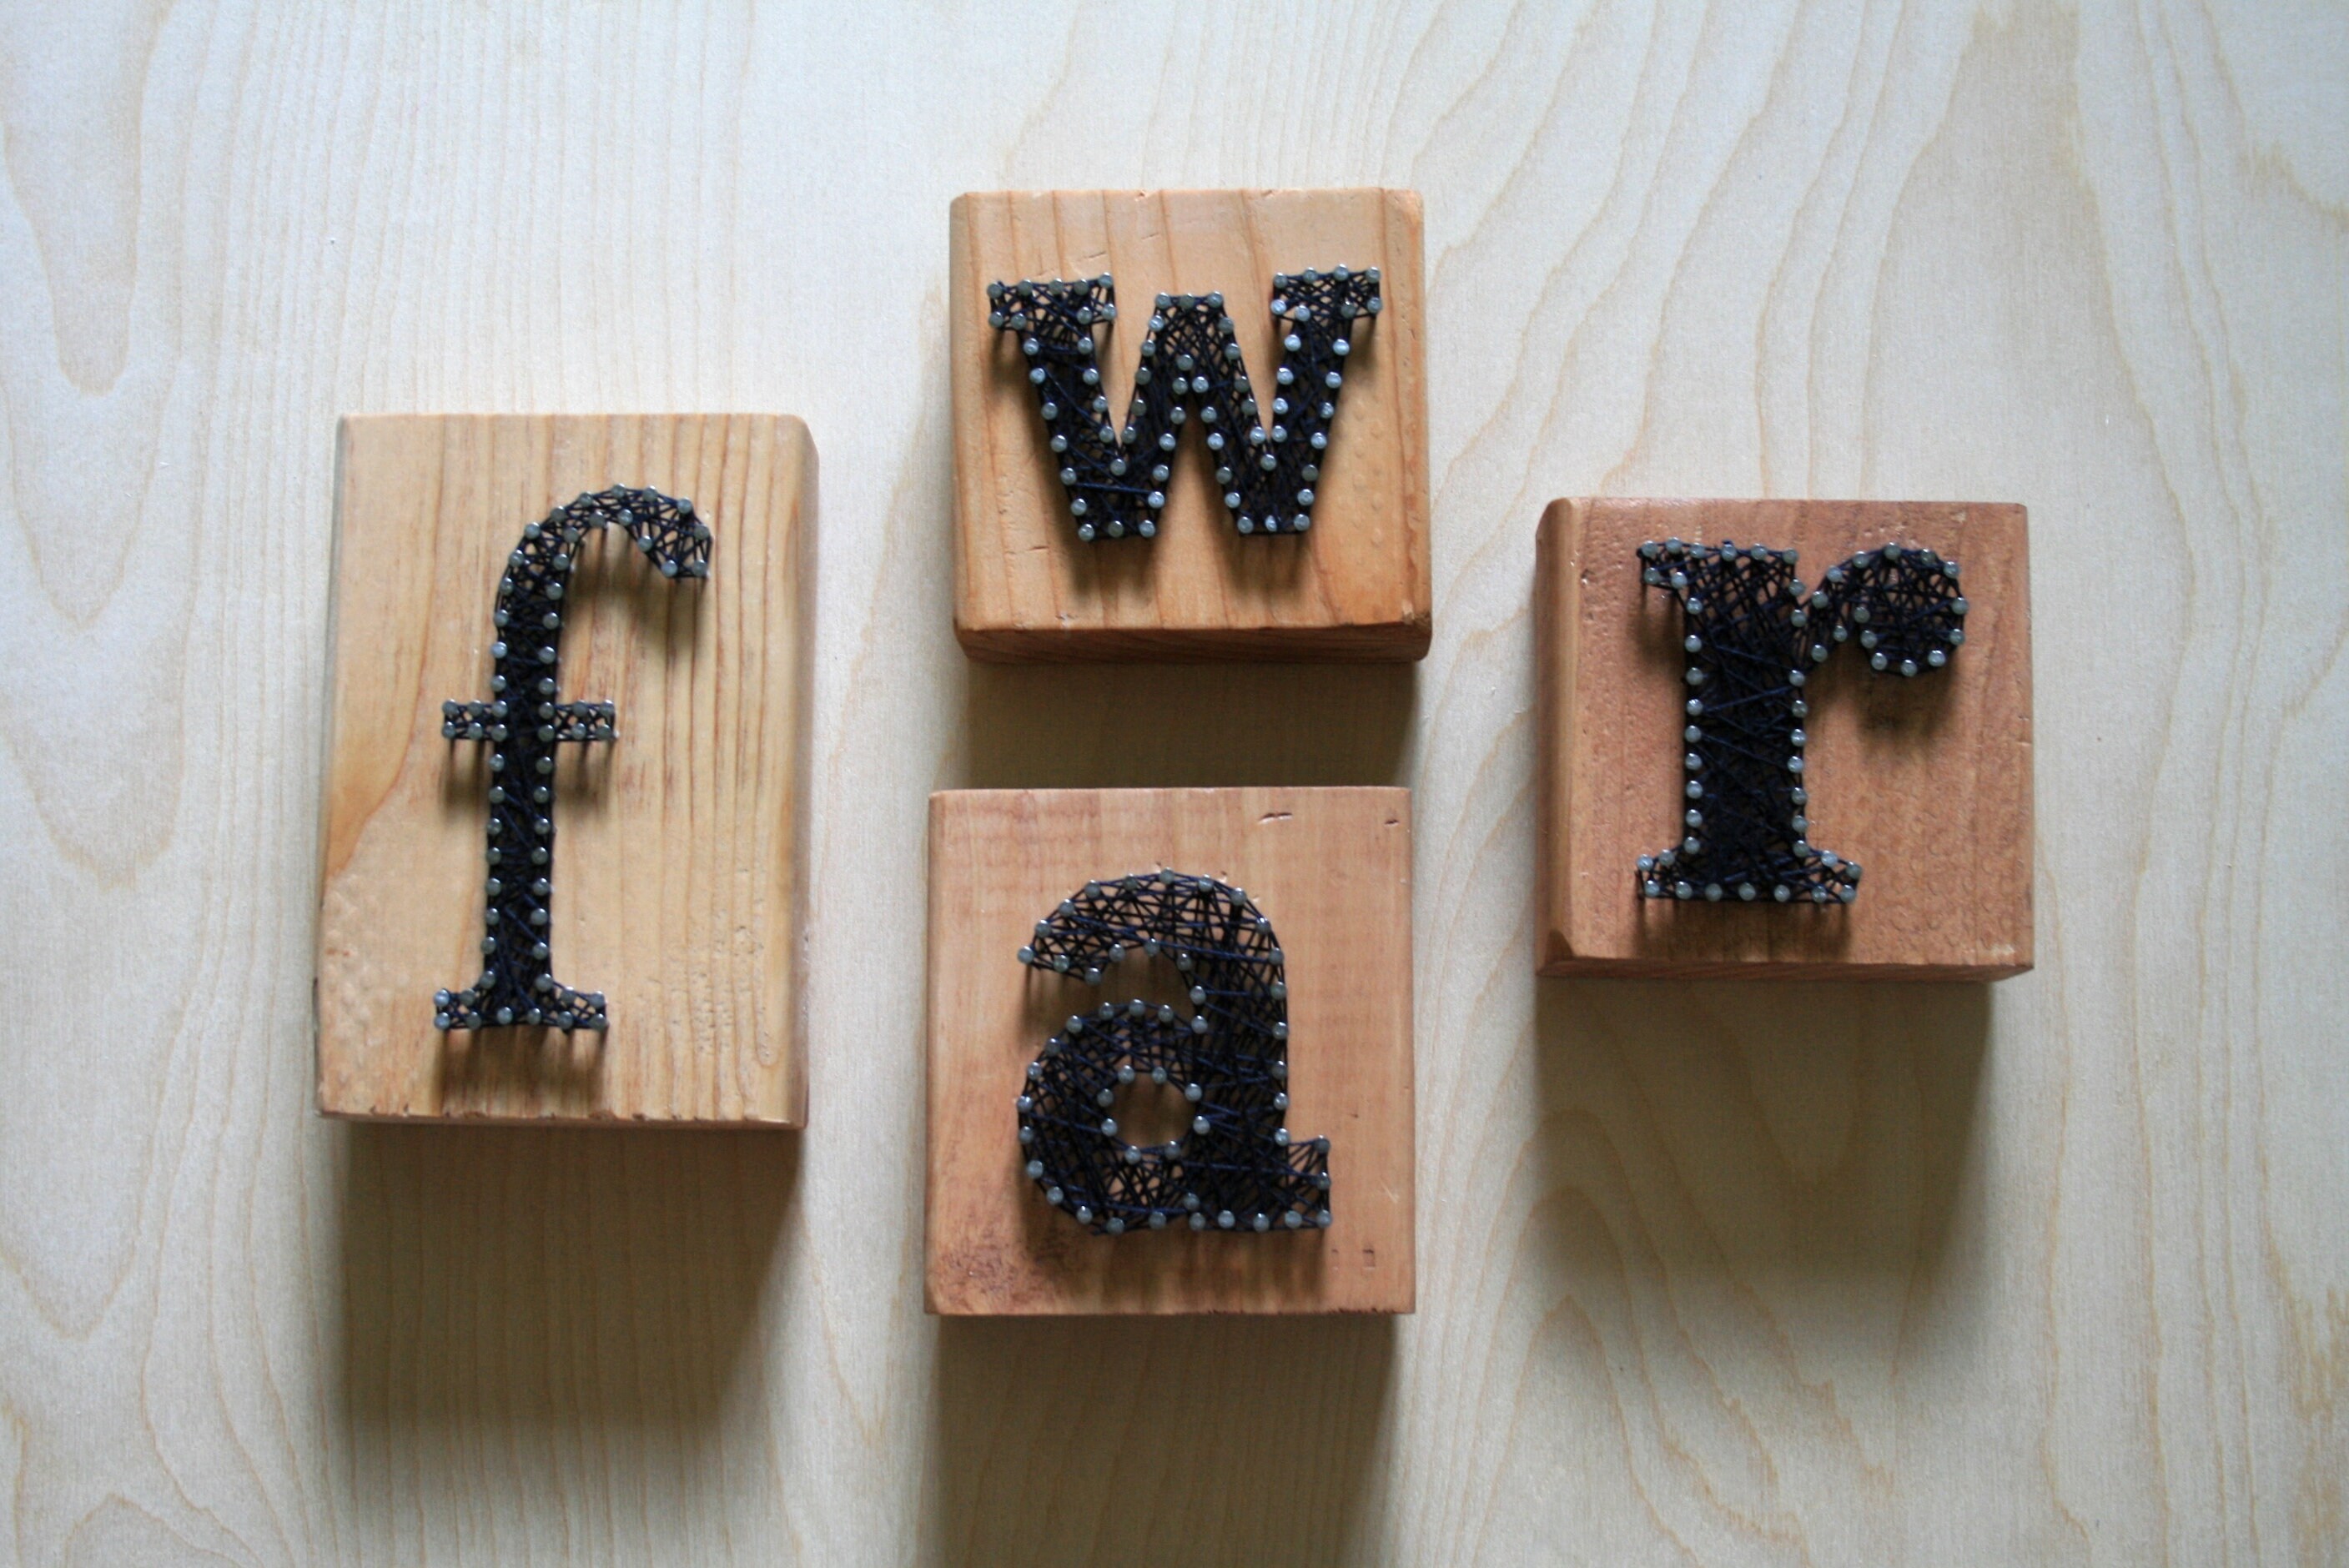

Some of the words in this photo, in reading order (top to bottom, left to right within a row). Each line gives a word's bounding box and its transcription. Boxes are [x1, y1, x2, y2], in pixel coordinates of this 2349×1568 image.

[435, 483, 712, 1031] f
[1636, 537, 1968, 903] r
[1017, 866, 1332, 1235] a
